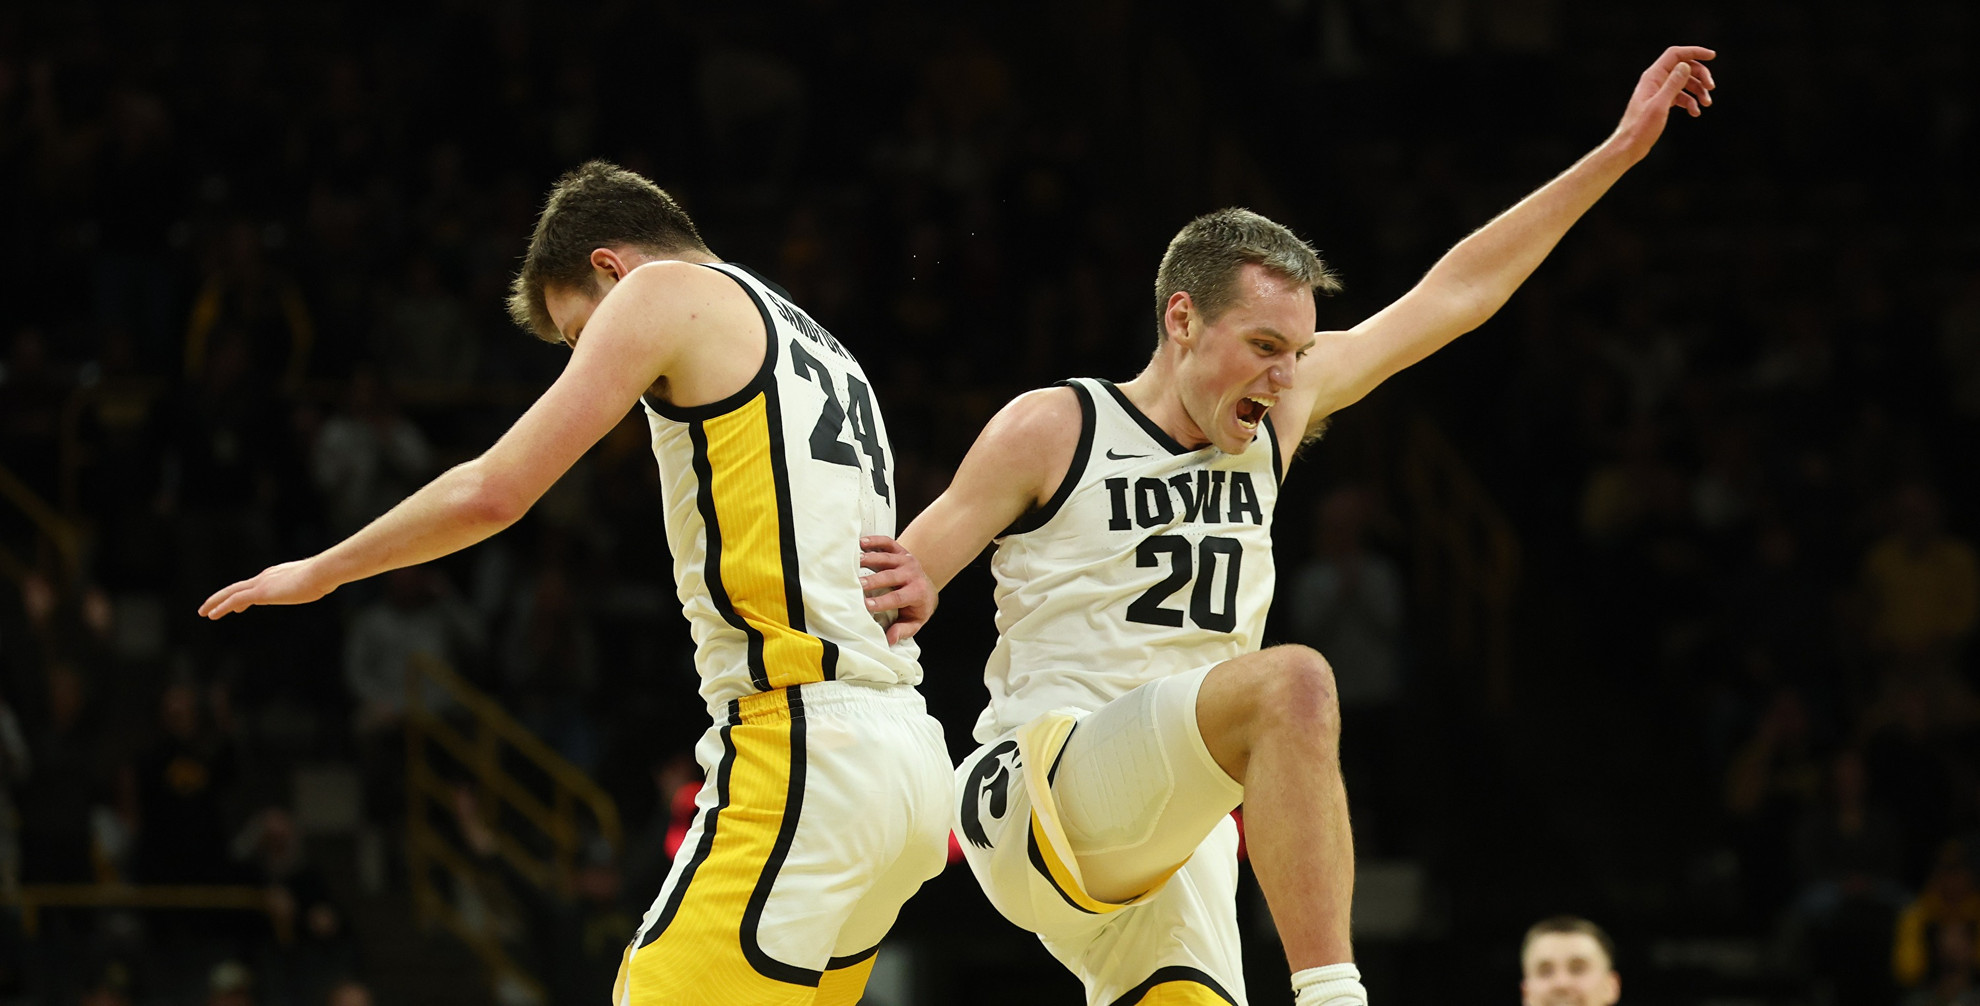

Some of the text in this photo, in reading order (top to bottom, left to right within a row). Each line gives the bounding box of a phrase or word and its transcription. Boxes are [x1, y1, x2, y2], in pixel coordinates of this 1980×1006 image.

[790, 338, 890, 508] 24
[1105, 470, 1263, 531] IOWA
[1126, 535, 1243, 634] 20
